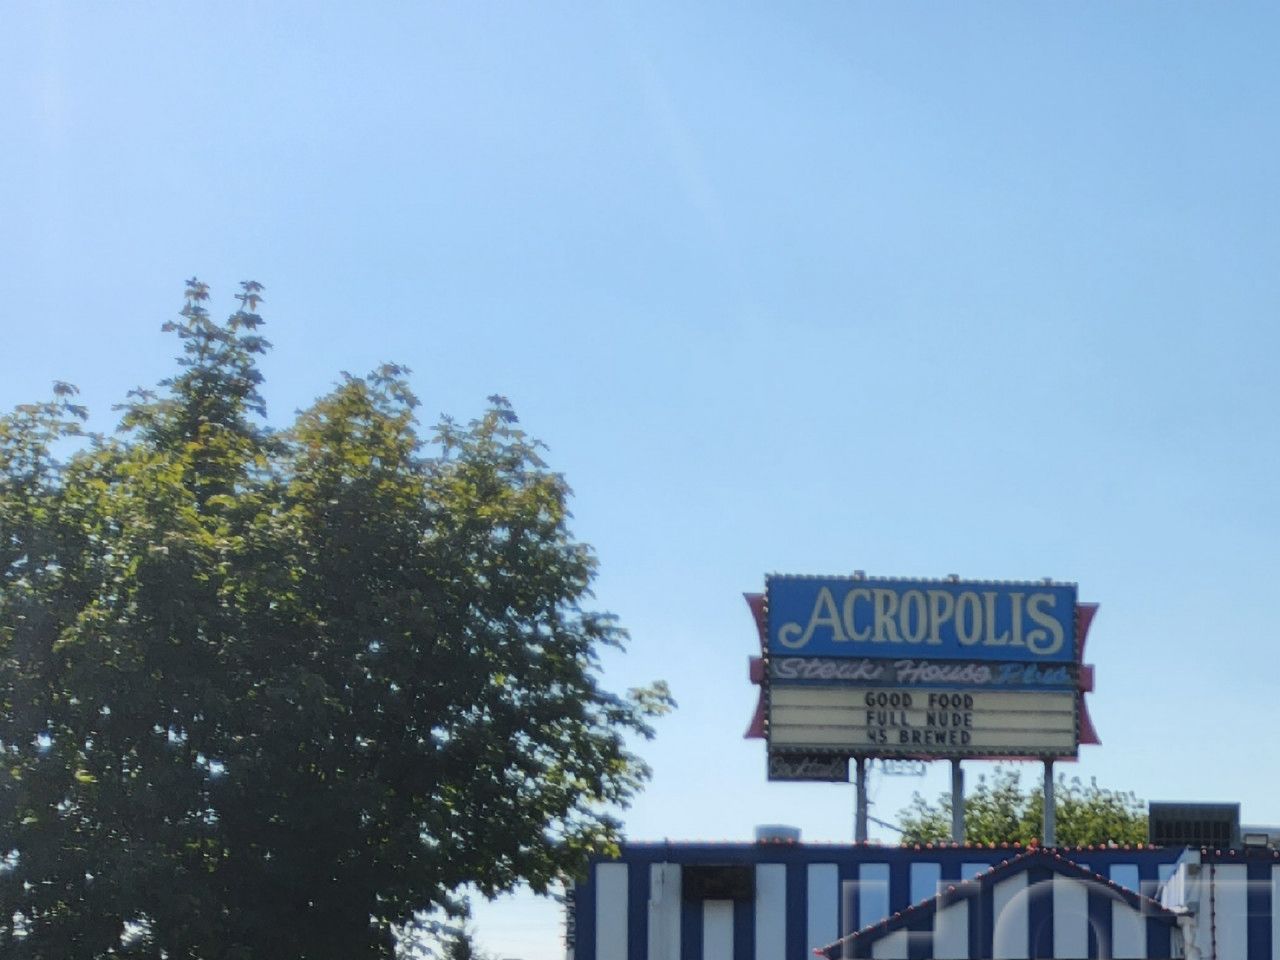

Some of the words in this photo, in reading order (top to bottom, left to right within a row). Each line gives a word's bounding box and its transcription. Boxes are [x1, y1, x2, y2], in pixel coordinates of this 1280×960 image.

[778, 586, 1065, 655] ACROPOLIS
[774, 658, 884, 680] Steak
[894, 660, 991, 683] House
[865, 692, 913, 708] GOOD
[928, 693, 974, 710] FOOD
[866, 711, 909, 727] FULL
[927, 711, 973, 728] NUDE
[899, 730, 972, 745] BREWED
